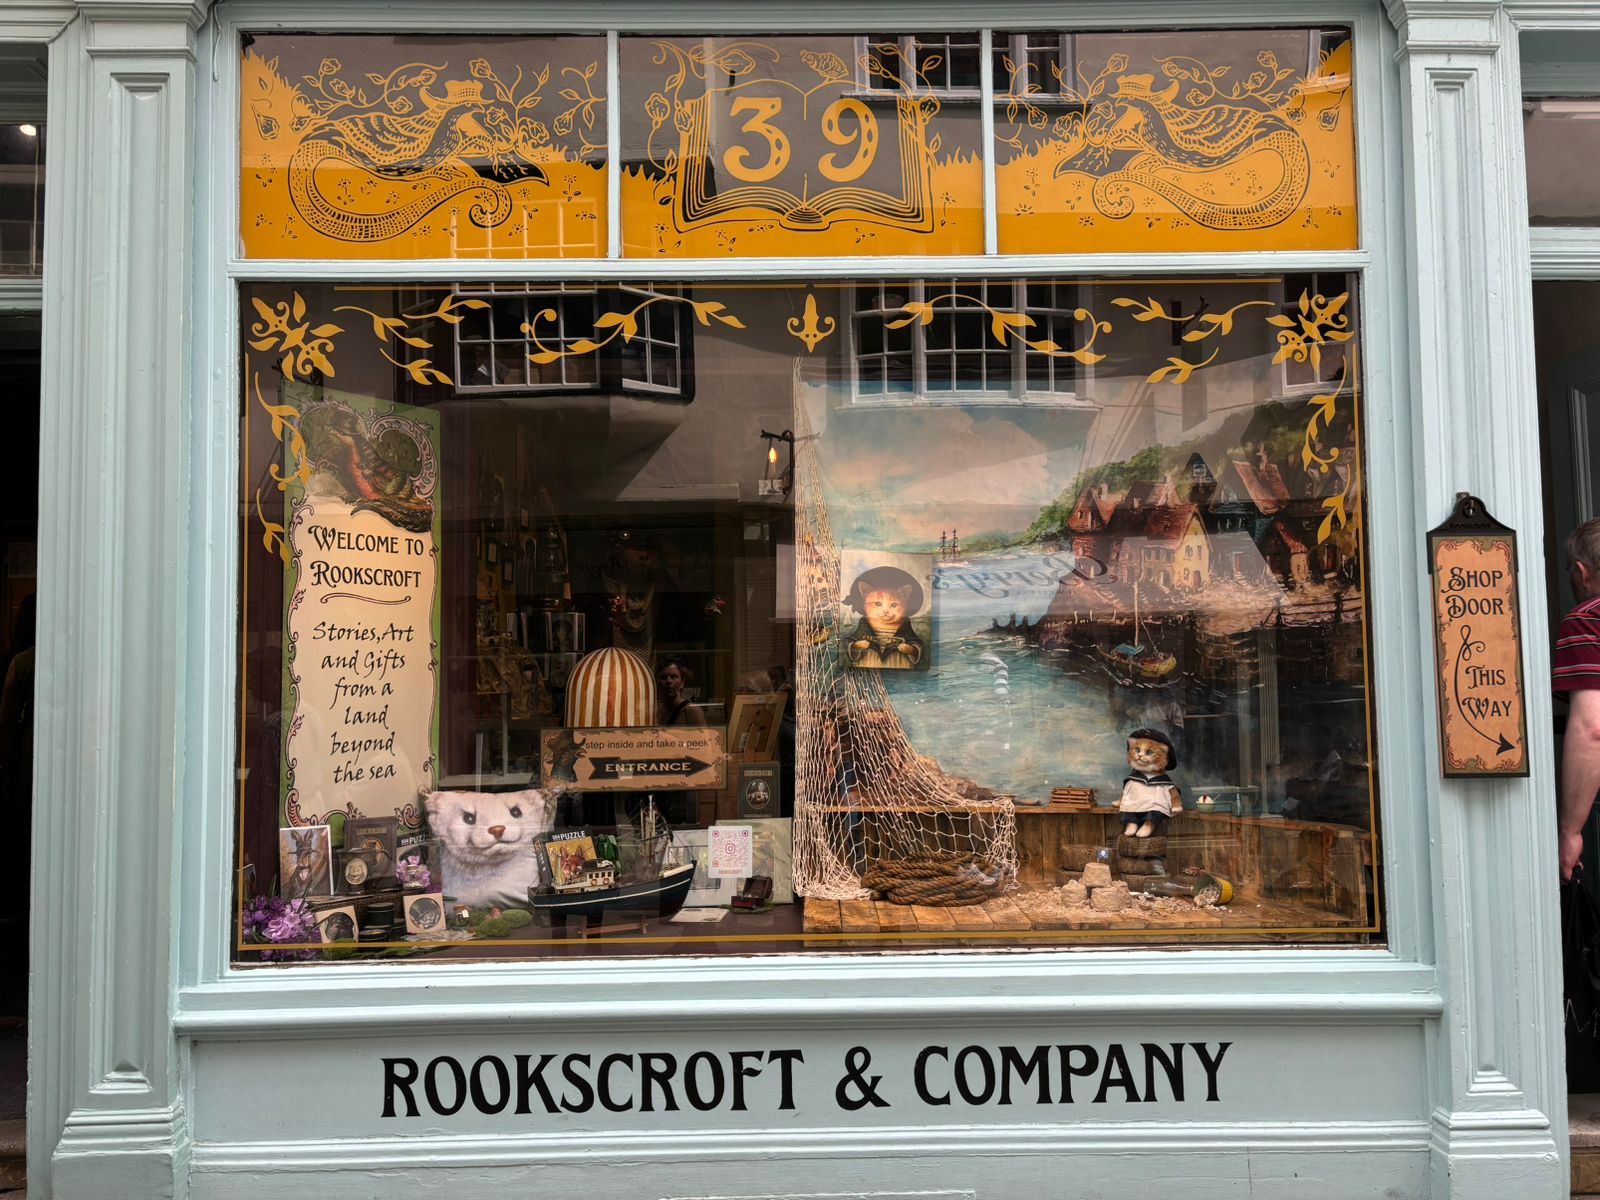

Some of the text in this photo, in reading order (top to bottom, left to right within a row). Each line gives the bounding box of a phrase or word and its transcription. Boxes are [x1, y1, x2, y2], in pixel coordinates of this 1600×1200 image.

[308, 525, 424, 555] WELCOME TO
[310, 560, 421, 588] ROOKSCROFT
[1441, 566, 1503, 593] SHOP
[1445, 594, 1504, 622] DOOR
[321, 648, 405, 680] and Gifts
[1465, 665, 1506, 689] THIS
[329, 676, 394, 710] from a
[344, 704, 389, 730] land
[1462, 697, 1512, 720] WAY
[330, 731, 396, 765] beyond
[607, 739, 634, 749] inside
[636, 739, 654, 748] and
[656, 739, 676, 748] take
[333, 760, 397, 784] the sea
[605, 762, 691, 773] ENTRANCE
[409, 834, 426, 845] PUZZ
[380, 1041, 1234, 1118] ROOKSCROFT & COMPANY
